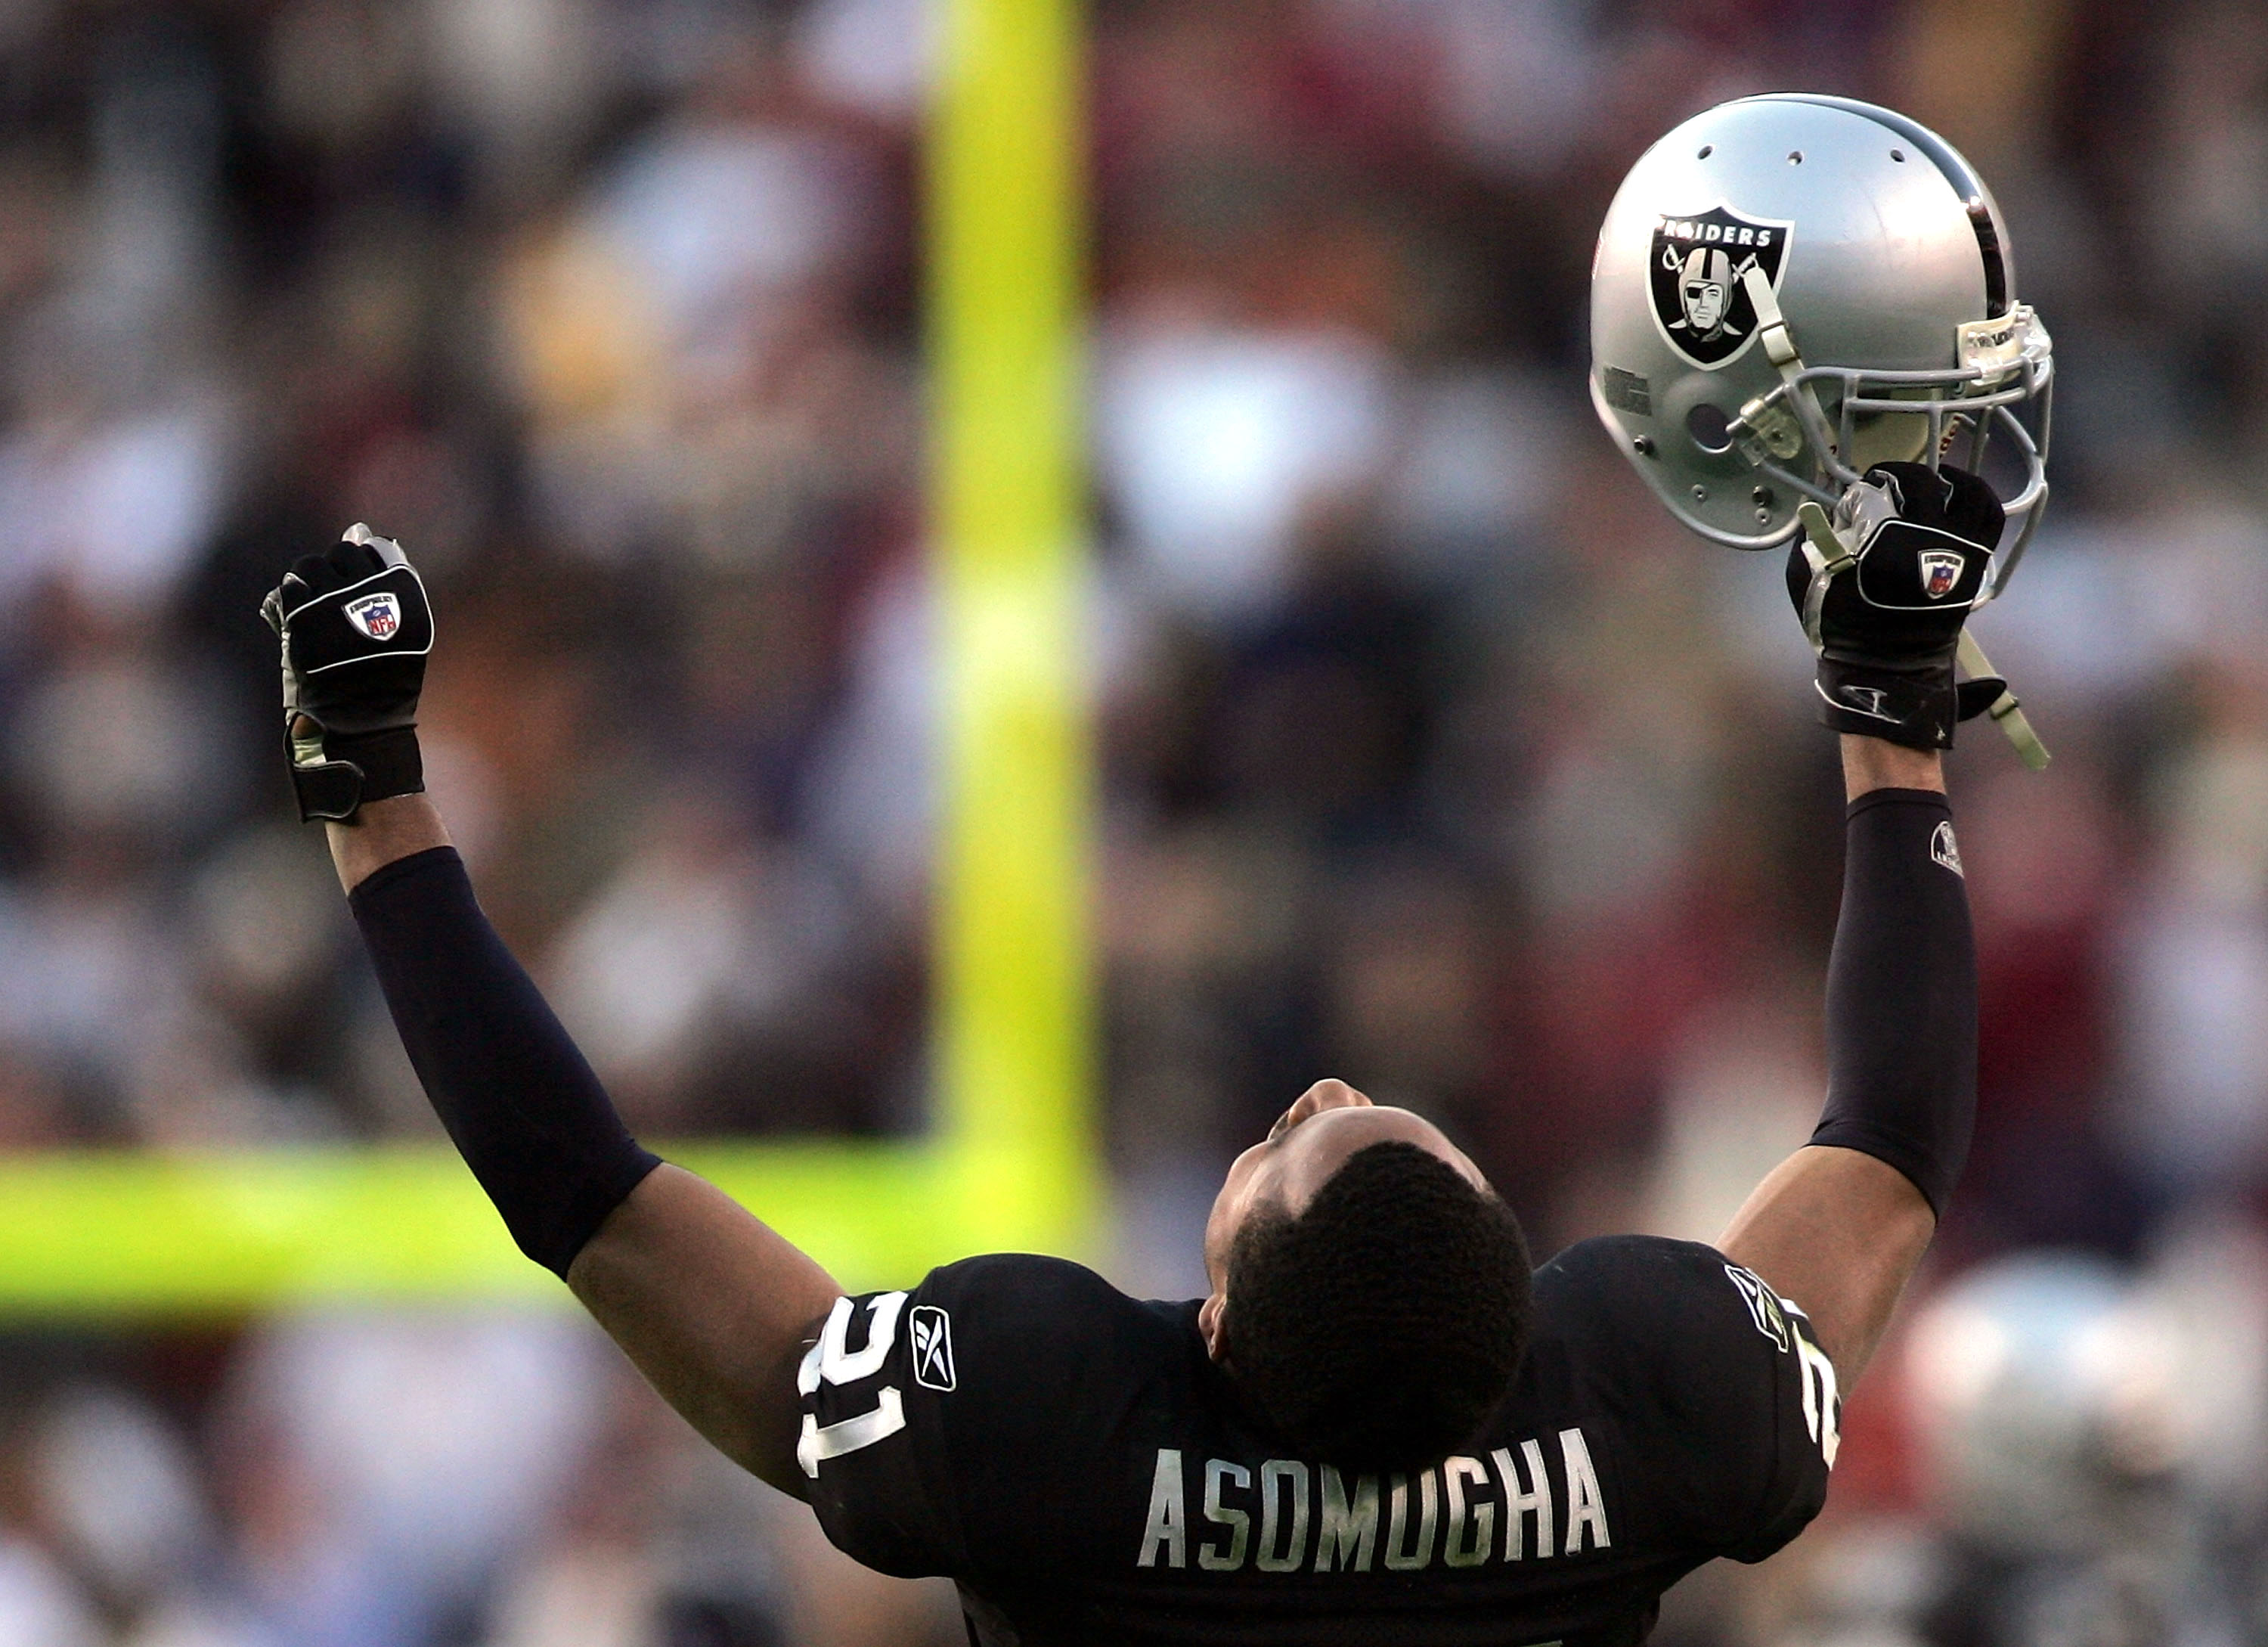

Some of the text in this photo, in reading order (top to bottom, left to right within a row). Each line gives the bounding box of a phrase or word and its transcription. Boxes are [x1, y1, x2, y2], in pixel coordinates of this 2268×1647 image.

[368, 613, 395, 634] NFL
[797, 1290, 909, 1478] 21
[1136, 1428, 1611, 1573] ASOMUGHA
